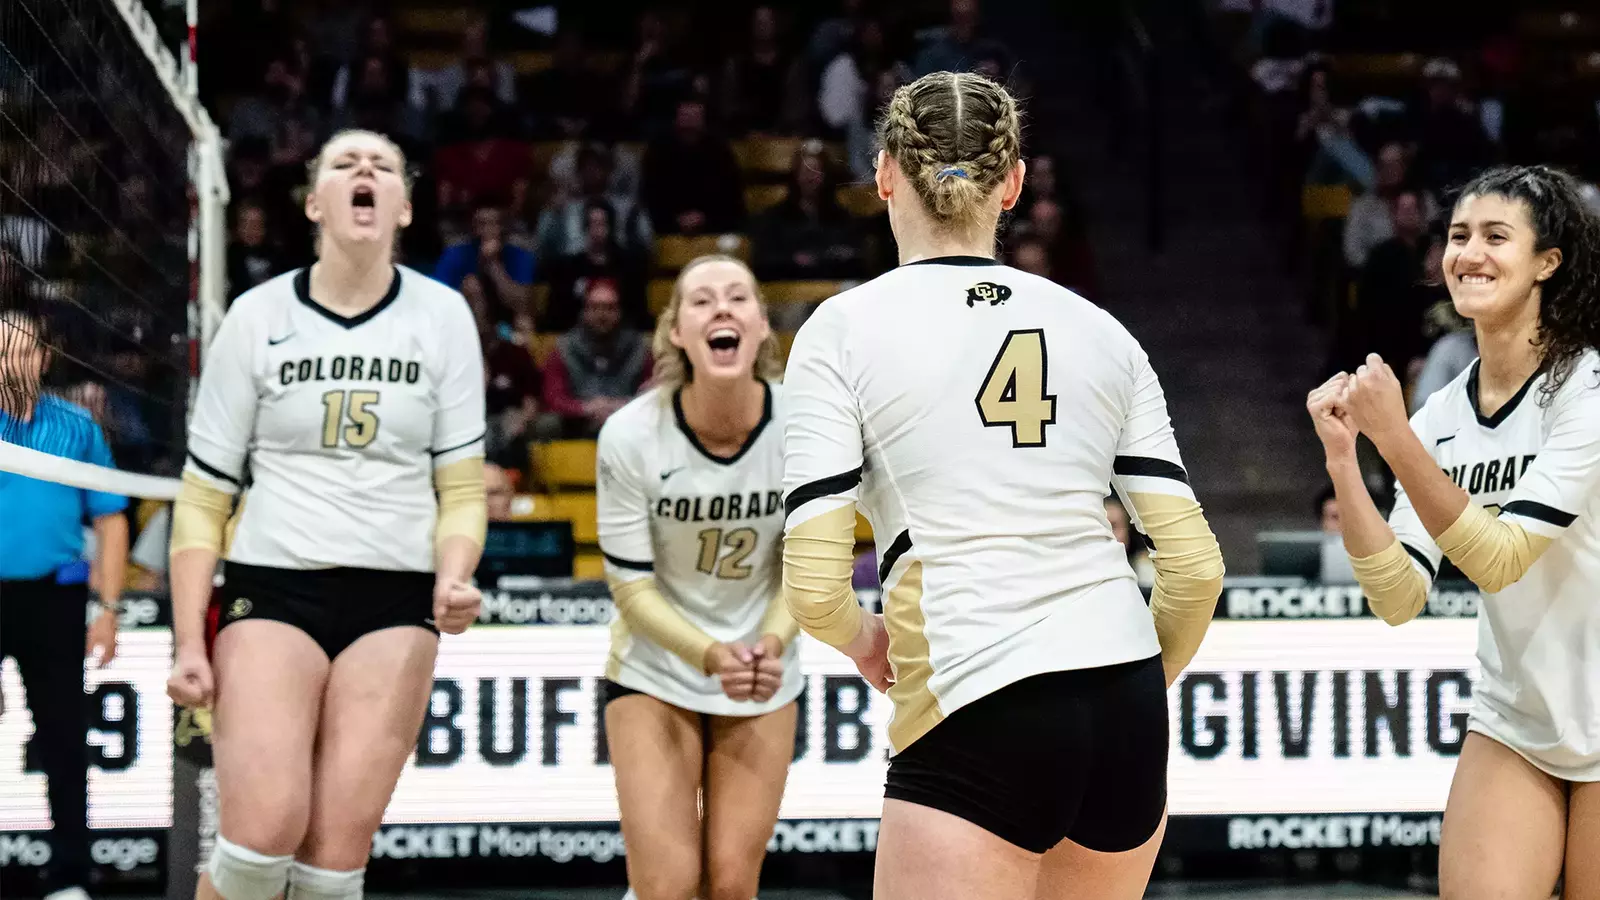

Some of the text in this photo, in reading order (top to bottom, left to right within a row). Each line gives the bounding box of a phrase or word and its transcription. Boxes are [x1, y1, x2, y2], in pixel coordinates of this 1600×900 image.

[280, 356, 420, 386] COLORADO
[975, 328, 1057, 448] 4
[321, 389, 380, 449] 15
[657, 490, 783, 522] COLORAD
[695, 526, 758, 580] 12
[1227, 586, 1364, 618] ROCKET
[1179, 669, 1472, 759] GIVING
[372, 826, 478, 858] OCKET
[766, 821, 880, 853] OCKET
[1228, 815, 1441, 849] ROCKET Mort
